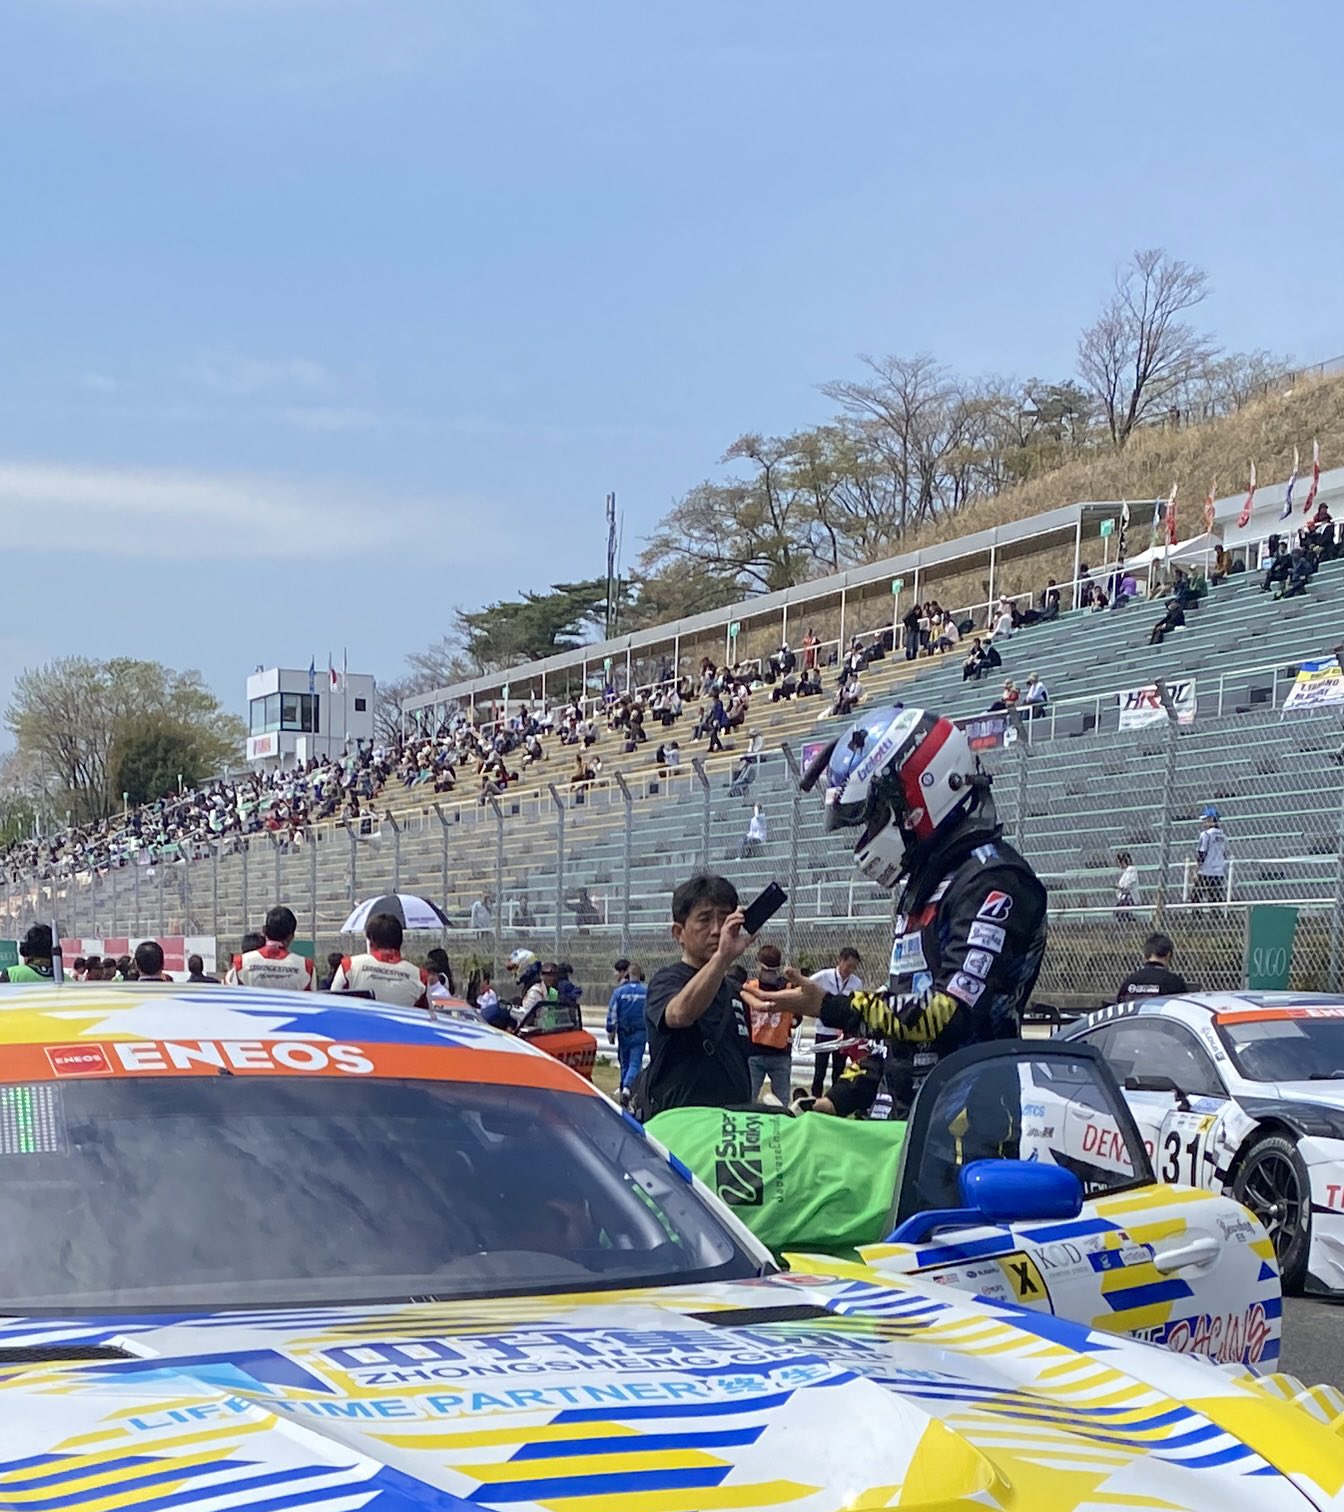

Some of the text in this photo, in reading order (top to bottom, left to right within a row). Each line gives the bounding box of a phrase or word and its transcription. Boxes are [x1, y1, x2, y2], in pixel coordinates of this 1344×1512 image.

[54, 1040, 375, 1075] ENEOS ENEOS
[1163, 1131, 1201, 1187] 31
[1009, 1262, 1039, 1297] X
[364, 1349, 713, 1386] ZHONGSHENG
[128, 1391, 416, 1431] LIFETIME
[425, 1378, 701, 1416] PARTNER
